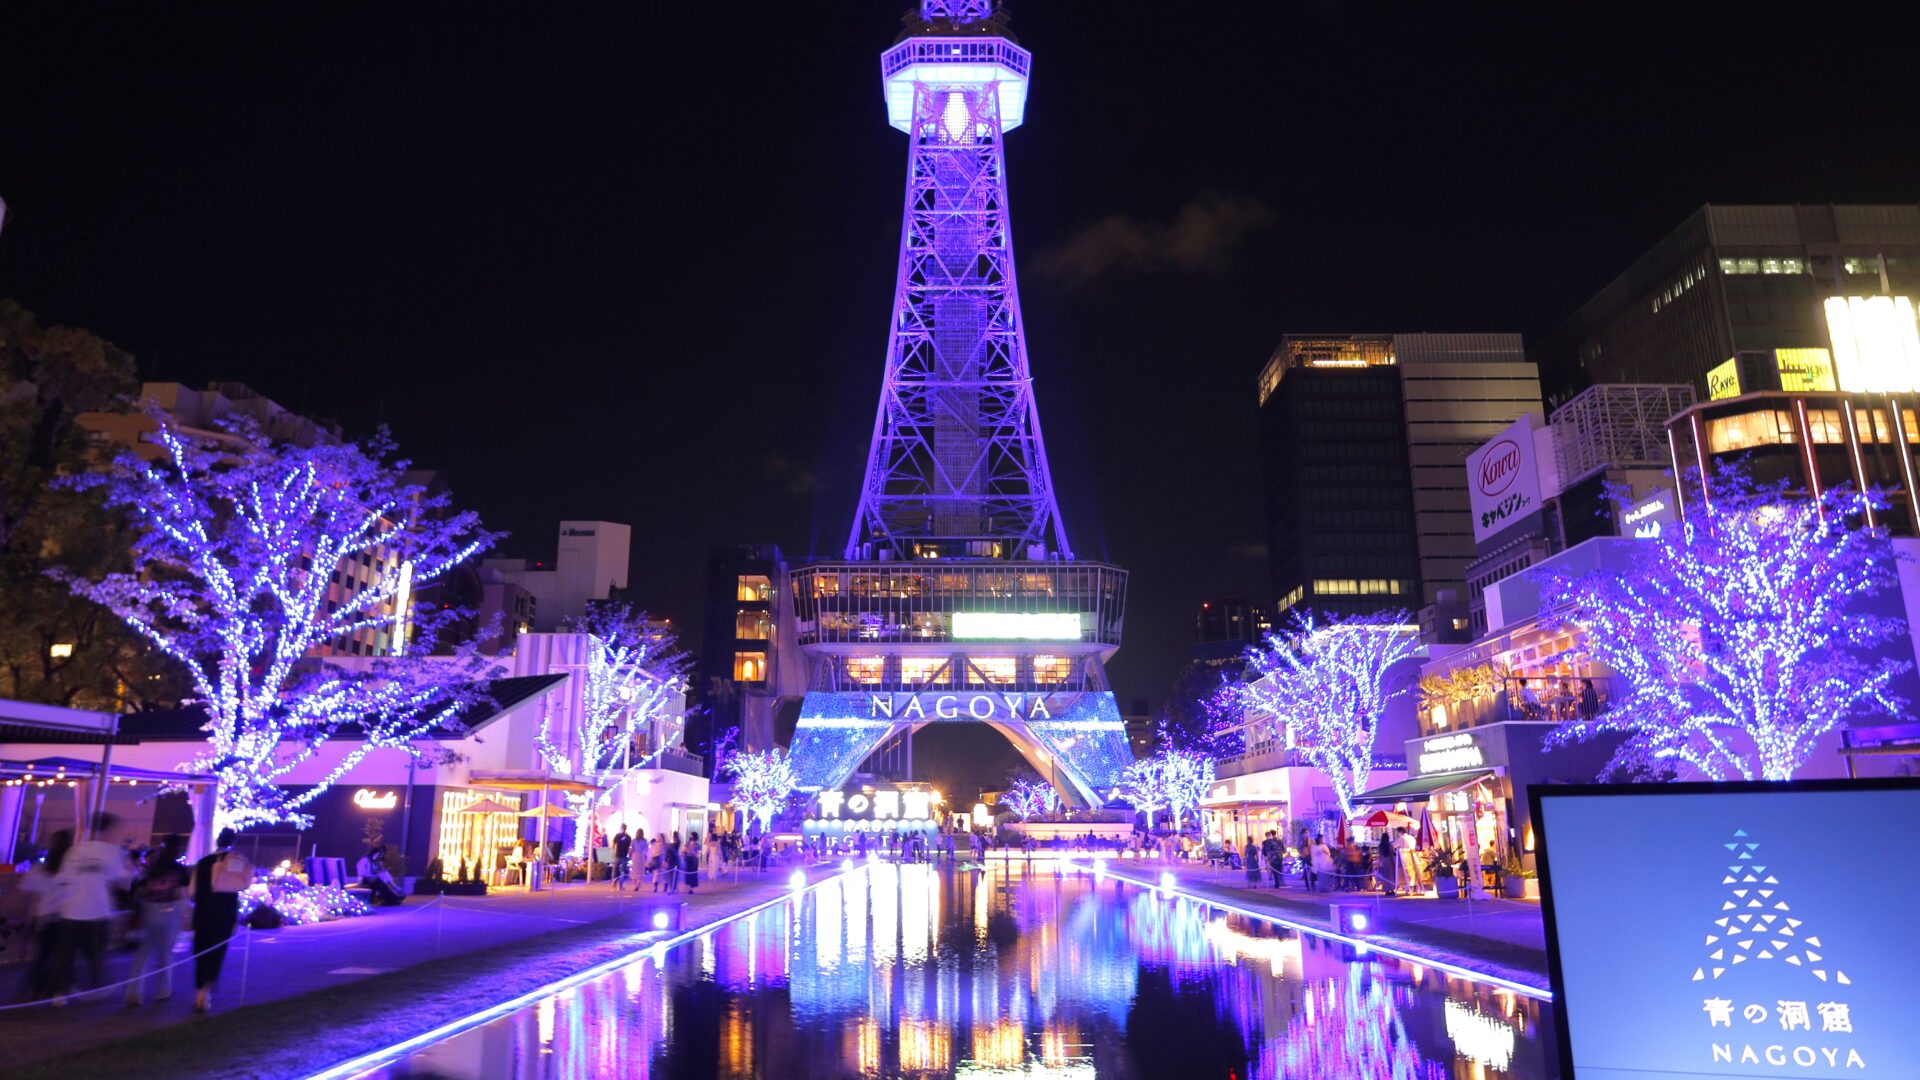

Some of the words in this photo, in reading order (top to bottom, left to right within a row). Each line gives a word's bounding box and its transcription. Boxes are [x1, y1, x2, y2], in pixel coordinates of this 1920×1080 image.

[1482, 449, 1519, 489] Kowa
[871, 694, 1051, 718] NAGOYA
[1703, 997, 1852, 1032] 青の洞窟
[1712, 1043, 1865, 1068] NAGOYA
